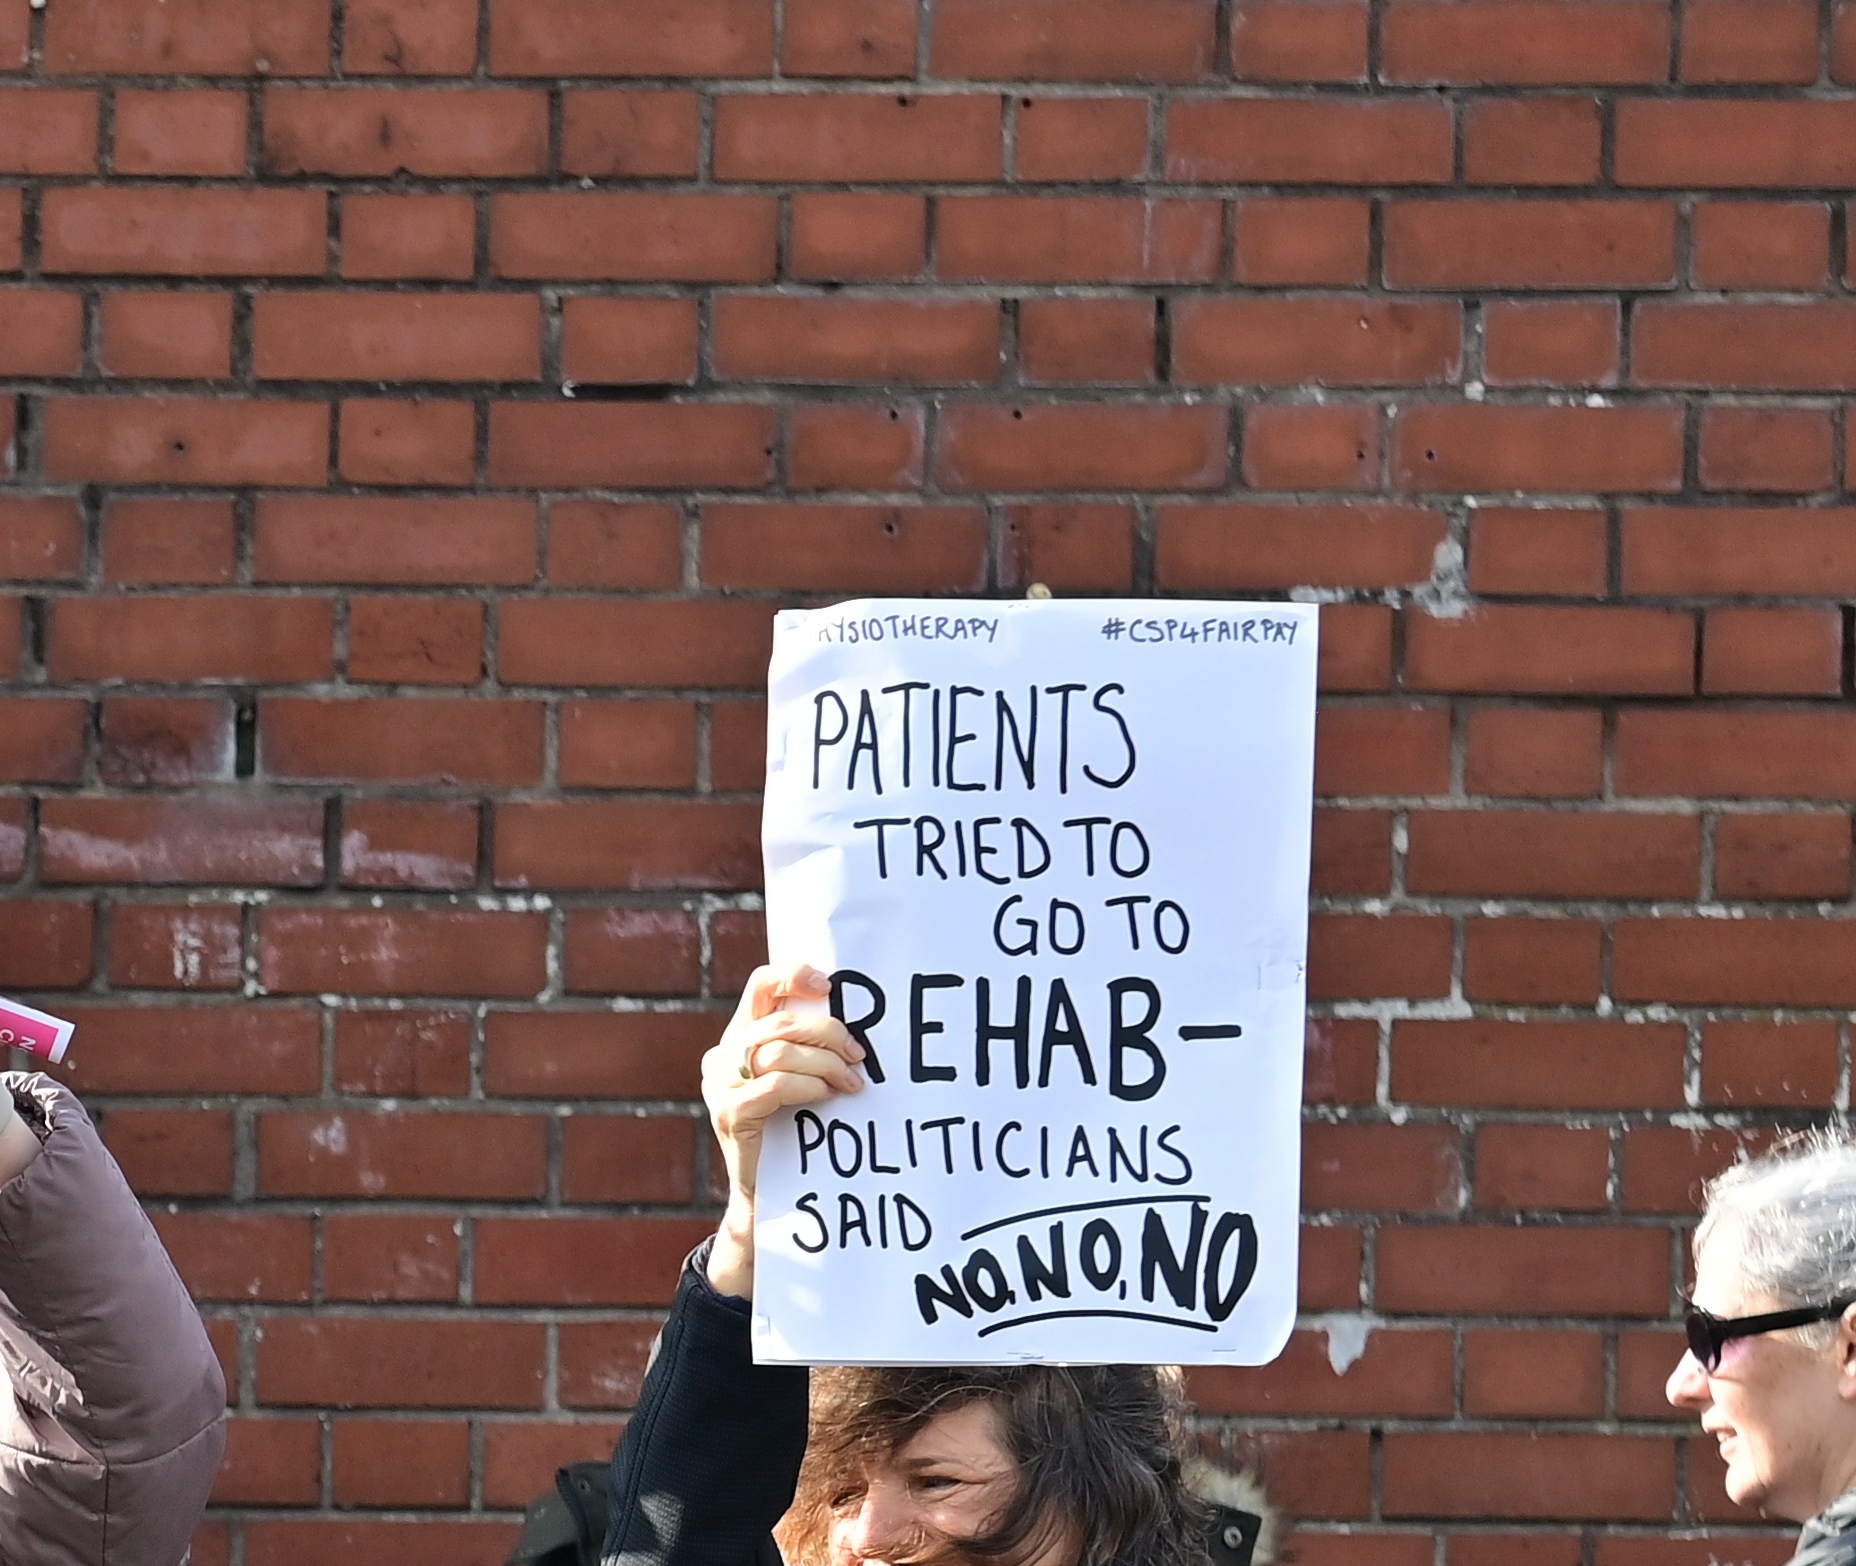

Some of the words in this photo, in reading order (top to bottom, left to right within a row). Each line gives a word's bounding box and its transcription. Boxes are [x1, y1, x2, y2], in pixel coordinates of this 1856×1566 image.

[812, 681, 1137, 794] PATIENTS
[853, 817, 1052, 884] TRIED
[1062, 818, 1150, 879] TO
[993, 894, 1086, 956] GO
[1106, 895, 1190, 955] TO
[794, 1110, 1193, 1185] POLITICIANS
[792, 1193, 933, 1252] SAID
